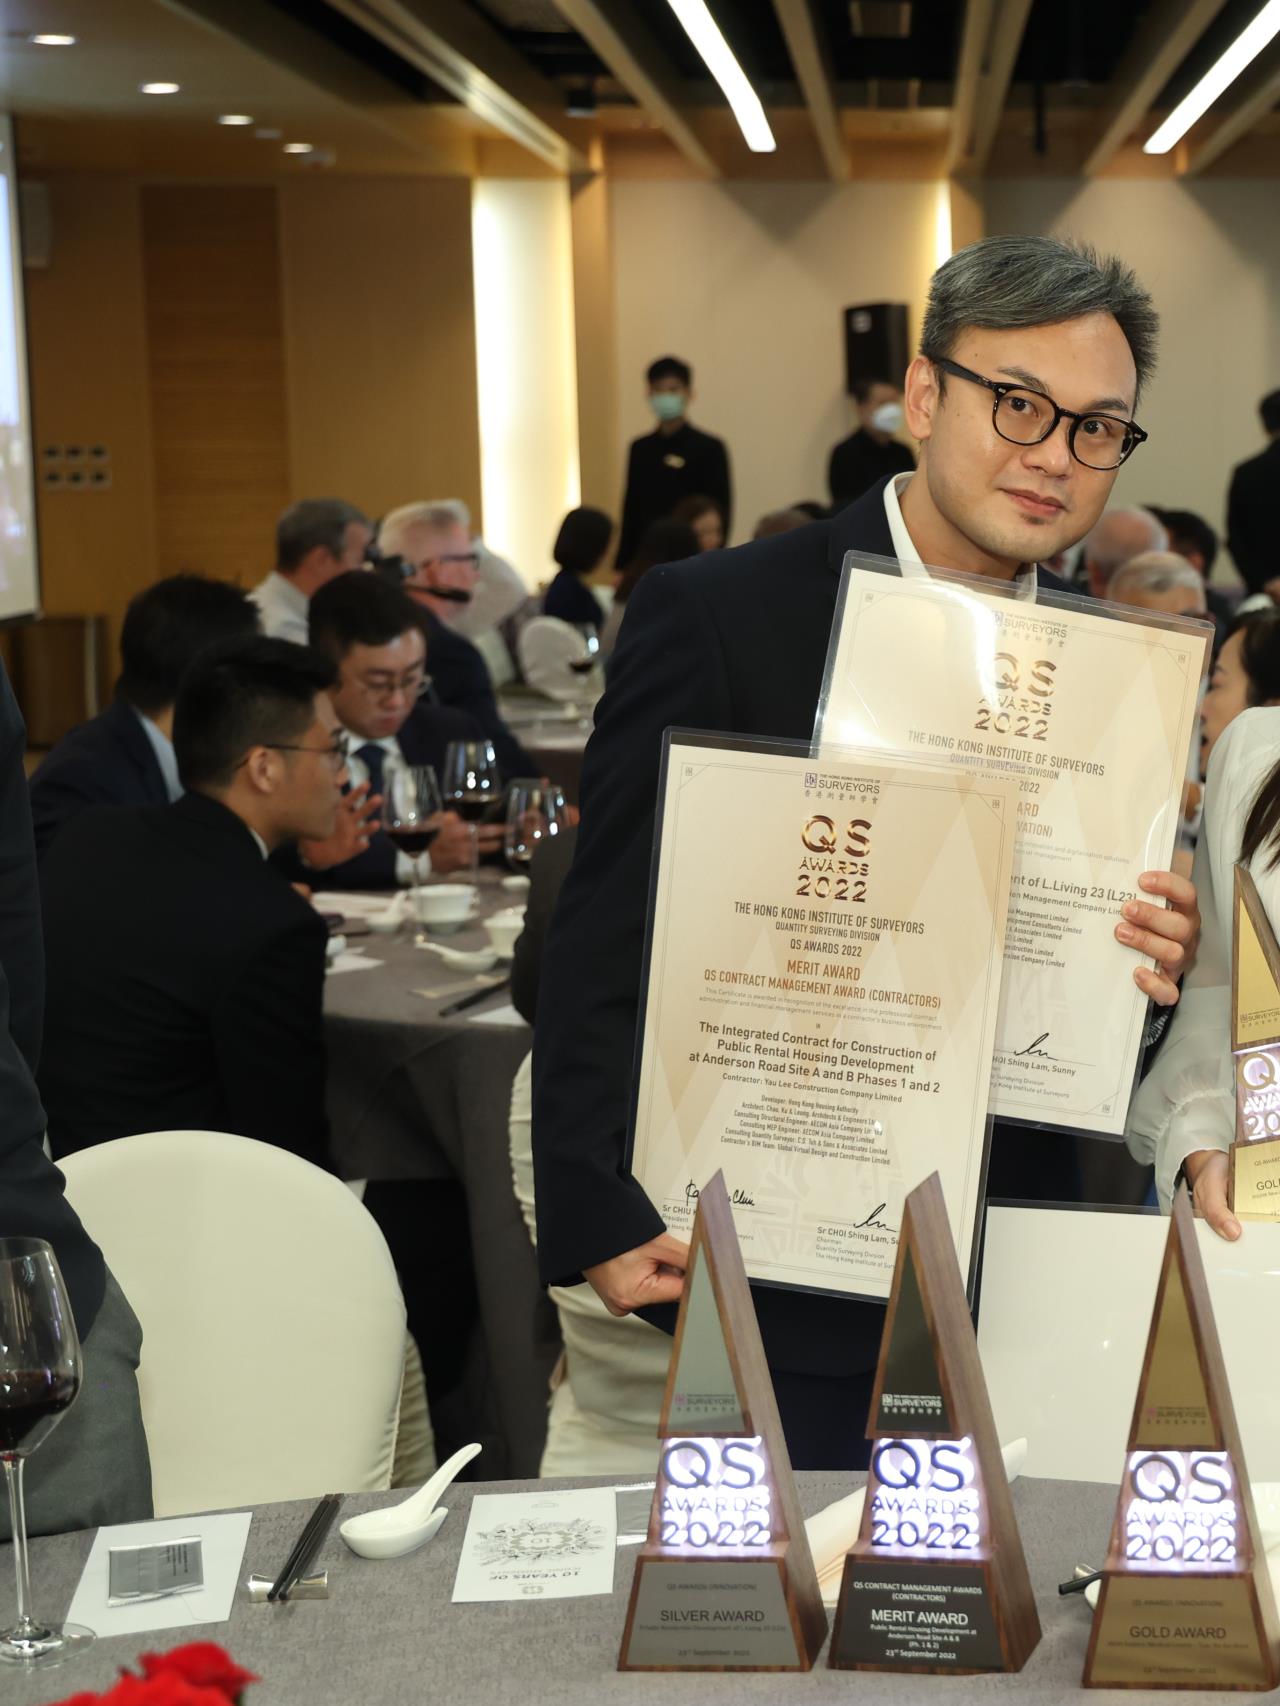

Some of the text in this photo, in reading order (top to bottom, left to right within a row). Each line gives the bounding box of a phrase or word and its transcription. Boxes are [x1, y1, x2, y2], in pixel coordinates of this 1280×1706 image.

[1004, 619, 1067, 639] SURVEYORS
[974, 709, 1048, 741] 2022
[908, 730, 1105, 777] THE HONG KONG INSTITUTE OF SURVEYORS
[950, 753, 1059, 780] QUANTITY SURVEYING DIVISION
[818, 780, 880, 794] SURVEYORS
[1019, 780, 1040, 794] 2022
[1016, 801, 1039, 818] ARD
[801, 815, 872, 858] QS
[800, 857, 869, 877] AWARDS
[796, 874, 867, 902] 2022
[1028, 877, 1041, 888] of
[1090, 887, 1104, 899] 23
[1023, 892, 1071, 907] Management
[1073, 901, 1106, 914] Company
[735, 901, 925, 935] THE HONG KONG INSTITUTE OF SURVEYORS
[1049, 914, 1069, 923] Limited
[775, 921, 880, 942] QUANTITY SURVEYING DIVISION
[1043, 931, 1062, 941] Limited
[790, 938, 862, 957] QS AWARDS 2022
[1034, 948, 1054, 957] Limited
[787, 959, 861, 981] MERIT AWARD
[1021, 954, 1045, 966] Company
[1045, 959, 1066, 968] Limited
[704, 968, 716, 981] QS
[719, 970, 766, 988] CONTRACT
[768, 976, 831, 996] MANAGEMENT
[832, 983, 865, 999] AWARD
[868, 988, 941, 1009] (CONTRACTORS)
[699, 1021, 936, 1061] The Integrated Contract for Construction of
[717, 1039, 914, 1074] Public Rental Housing Development
[992, 1055, 1076, 1077] HOI Shing Lam, Sunny
[689, 1052, 940, 1093] at Anderson Road Site A and B Phases 1 and 2
[722, 1072, 902, 1103] Contractor: Yau Lee Construction Company Limited
[672, 1206, 690, 1215] CHIU
[828, 1228, 846, 1237] CHOI
[848, 1231, 869, 1242] Shing
[871, 1234, 889, 1245] Lam,
[662, 1440, 758, 1489] QS
[872, 1440, 966, 1492] QS
[1130, 1454, 1228, 1504] QS
[661, 1496, 765, 1512] AWARDS
[872, 1496, 970, 1515] AWARDS
[660, 1520, 764, 1548] 2022
[871, 1519, 972, 1549] 2022
[1127, 1534, 1233, 1562] 2022
[864, 1582, 900, 1591] CONTRACT
[901, 1583, 951, 1593] MANAGEMENT
[952, 1586, 982, 1595] AWARDS
[892, 1592, 946, 1603] (CONTRACTORS)
[660, 1610, 765, 1622] SILVER AWARD
[871, 1609, 968, 1625] MERIT AWARD
[1129, 1626, 1227, 1639] GOLD AWARD
[899, 1649, 937, 1659] September
